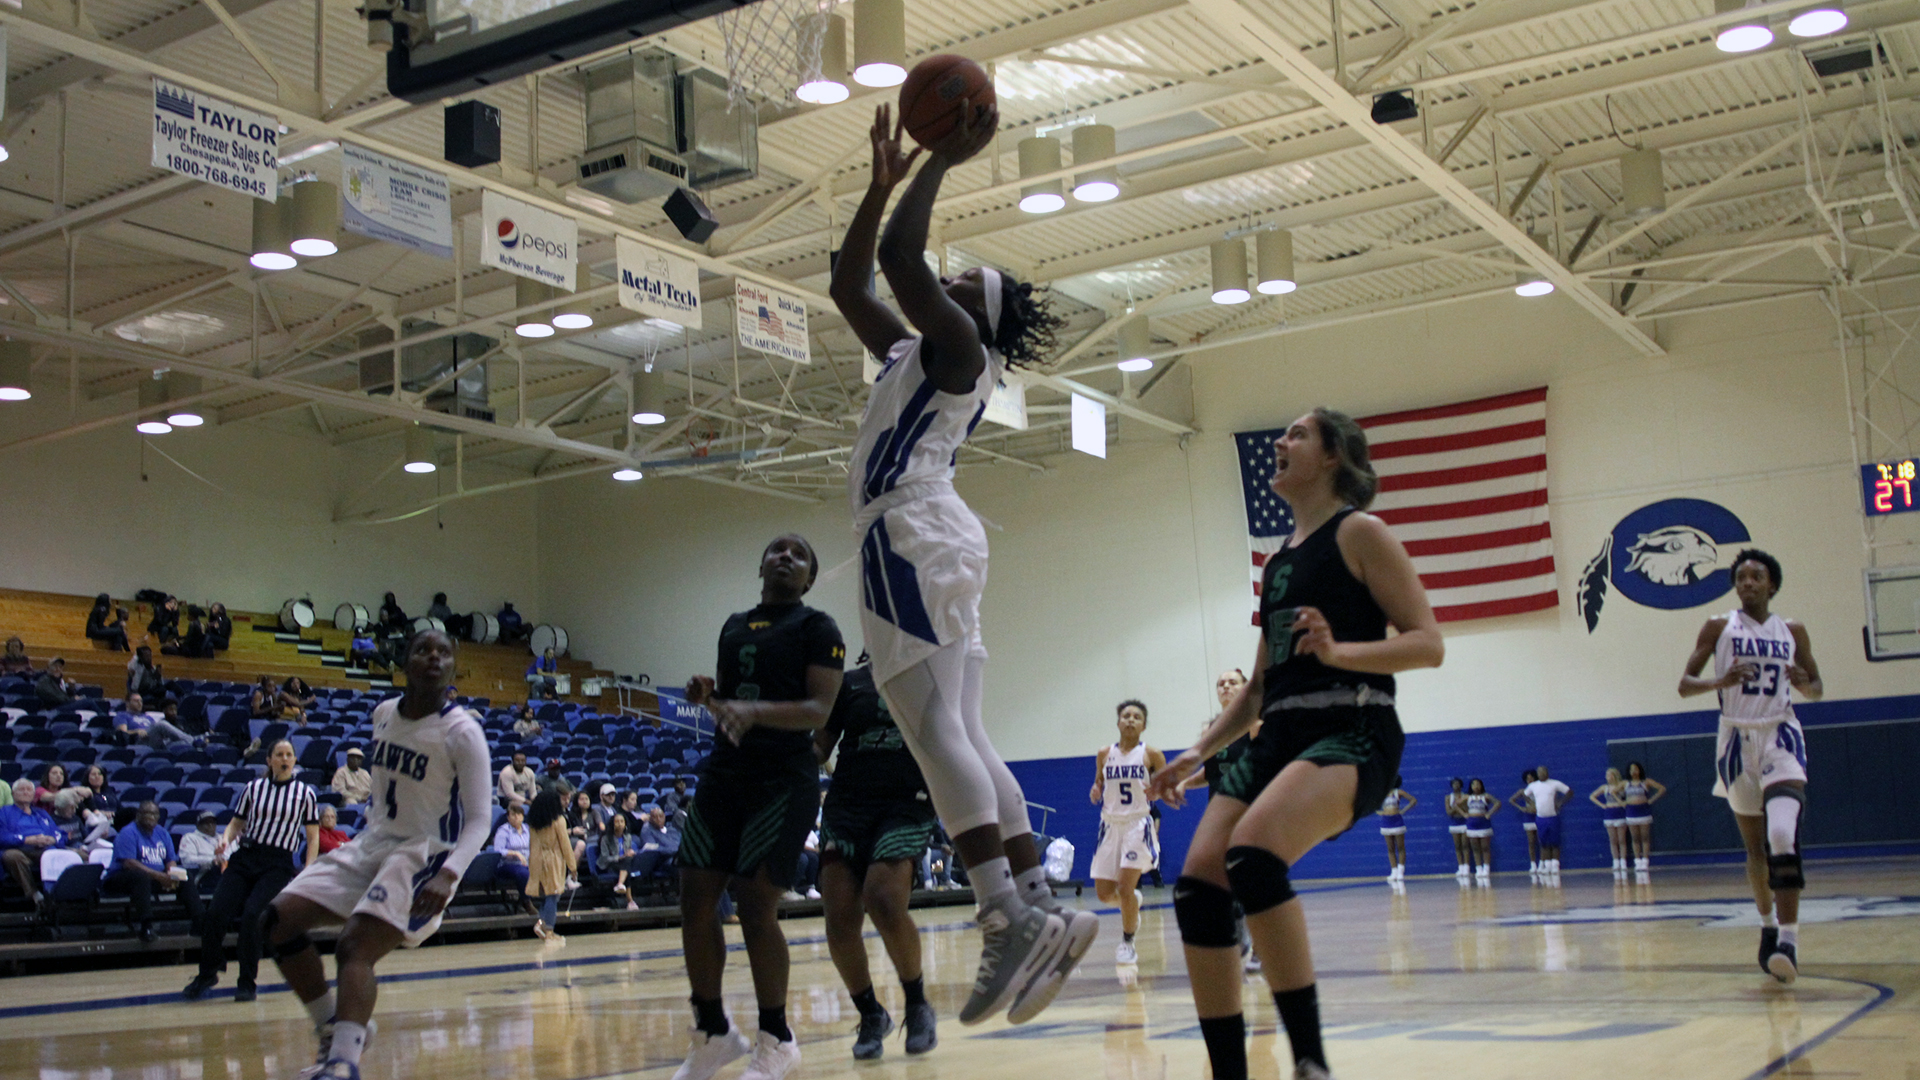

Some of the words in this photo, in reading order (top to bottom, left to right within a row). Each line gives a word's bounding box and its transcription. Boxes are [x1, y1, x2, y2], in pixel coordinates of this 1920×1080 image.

[198, 105, 277, 146] TAYLOR
[155, 114, 187, 142] Taylor
[190, 126, 229, 155] Freezer
[232, 140, 260, 166] Sales
[263, 150, 278, 171] Co.
[180, 142, 240, 172] Chesapeake,
[243, 162, 256, 175] Va
[166, 153, 267, 196] 1800-768-6945
[389, 176, 420, 193] MOBILE
[422, 187, 447, 202] CRISIS
[390, 184, 413, 198] TEAM
[522, 233, 568, 260] pepsi
[499, 253, 534, 273] McPherson
[535, 265, 565, 284] Beverage
[622, 268, 662, 296] Metal
[664, 281, 698, 308] Tech
[737, 283, 756, 300] Central
[778, 296, 792, 312] Quick
[792, 301, 804, 316] Lane
[740, 333, 753, 347] THE
[755, 338, 791, 357] AMERICAN
[792, 348, 806, 361] WAY
[1877, 460, 1916, 480] 7:18
[1874, 478, 1912, 512] 27
[1268, 563, 1293, 603] S
[739, 643, 757, 677] S
[1731, 637, 1790, 660] HAWKS
[1741, 662, 1781, 697] 23
[1105, 765, 1145, 780] HAWKS
[1119, 782, 1133, 805] 5
